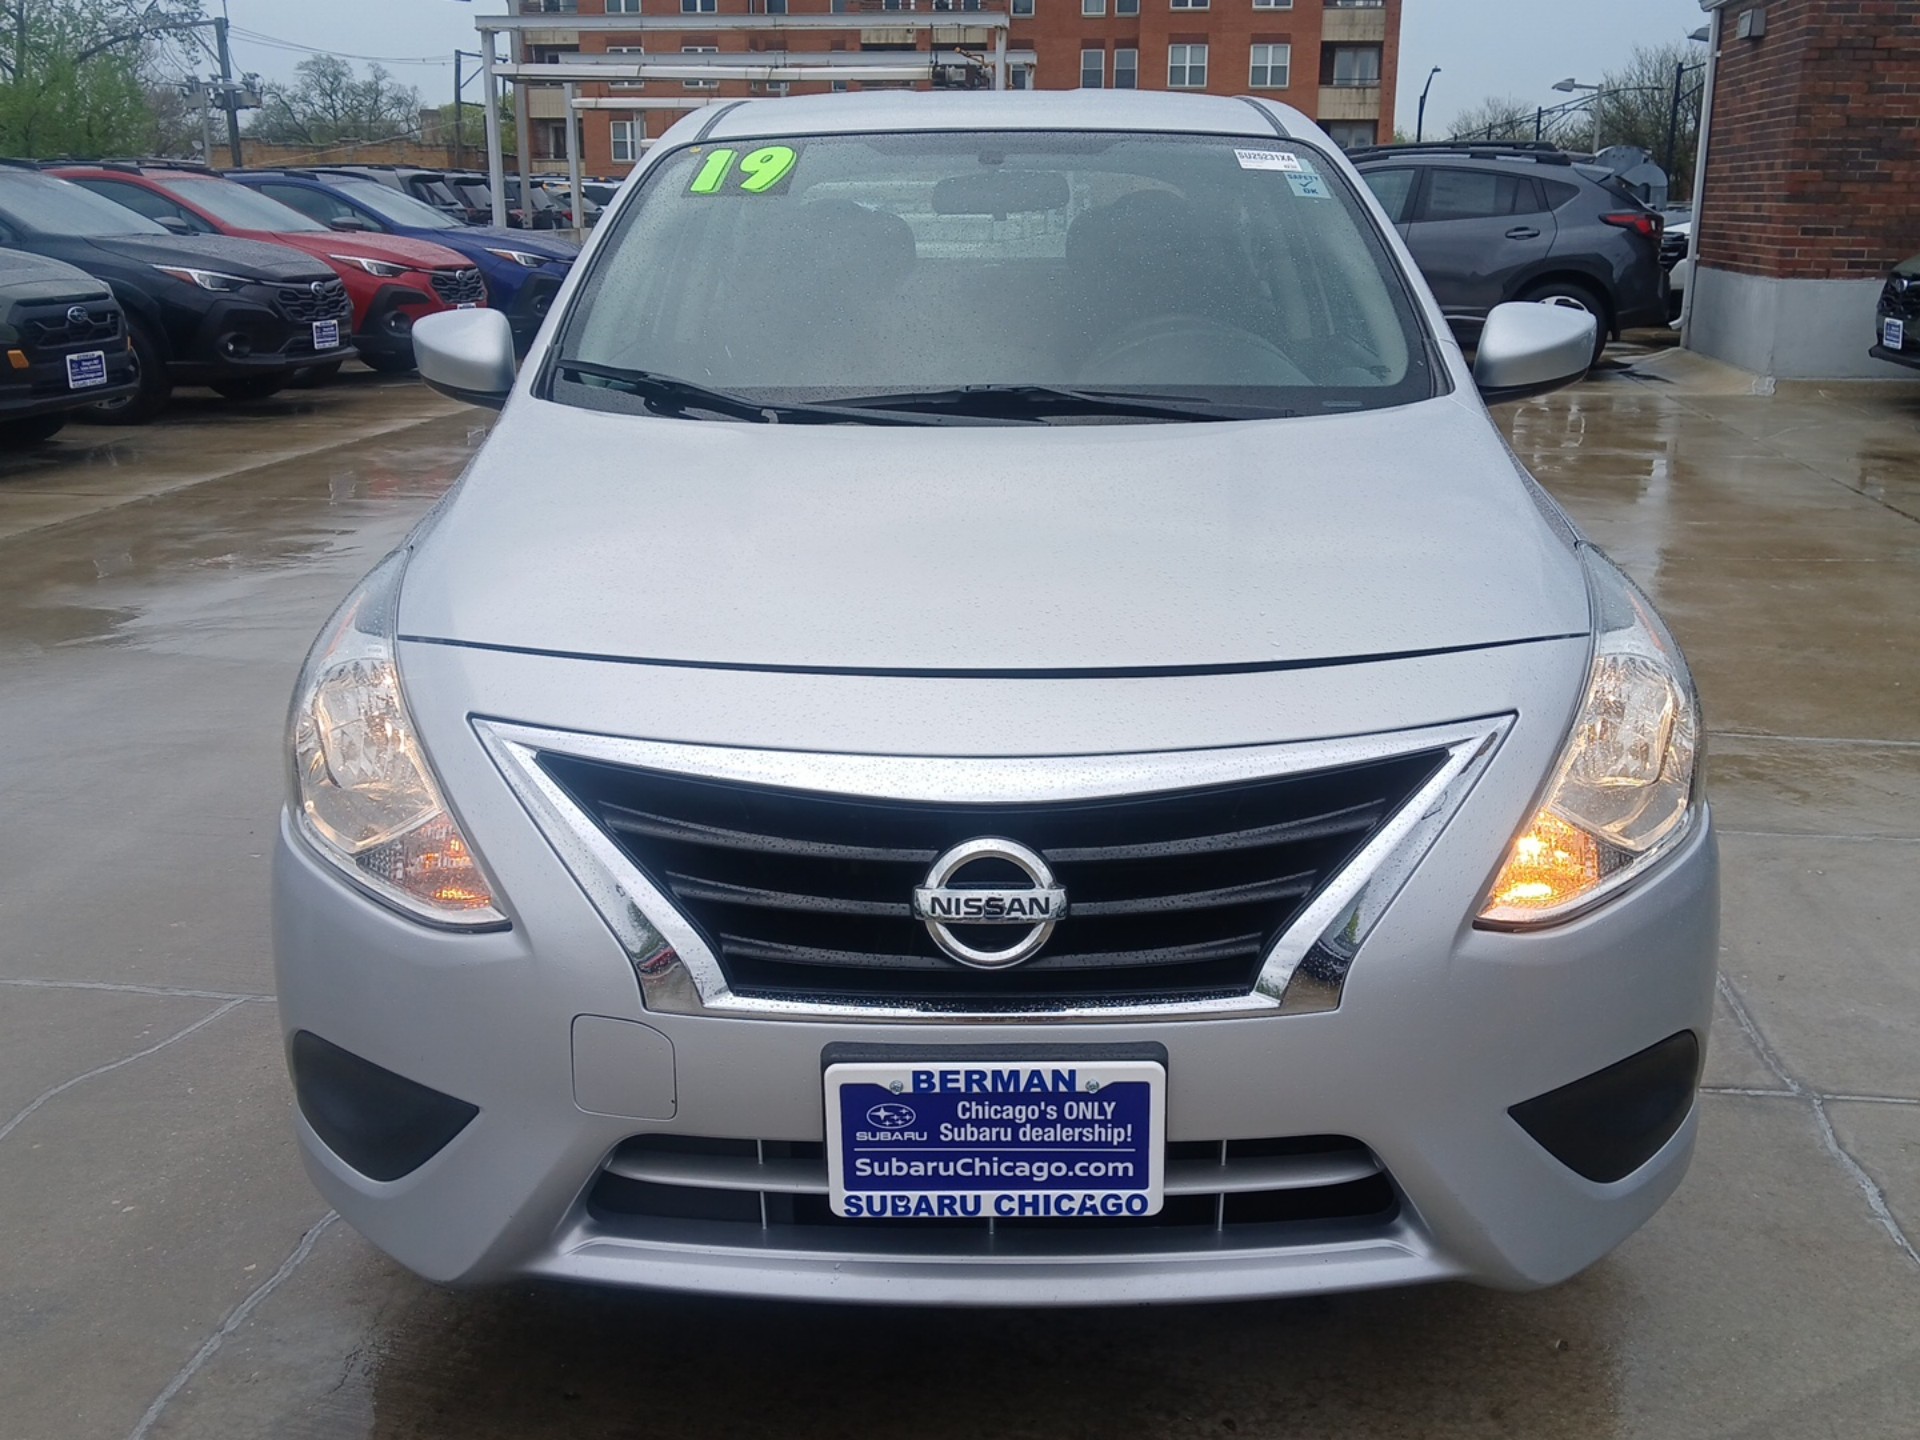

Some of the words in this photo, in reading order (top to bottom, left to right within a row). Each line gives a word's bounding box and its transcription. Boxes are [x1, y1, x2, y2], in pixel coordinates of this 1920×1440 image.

[690, 145, 797, 194] 19
[931, 896, 1050, 917] NISSAN
[911, 1069, 1077, 1093] BERMAN
[957, 1101, 1057, 1122] Chicago's
[1064, 1101, 1117, 1120] ONLY
[855, 1131, 928, 1141] SUBARU
[939, 1123, 1012, 1142] Subaru
[1018, 1123, 1133, 1145] dealership!
[855, 1157, 1134, 1181] SubaruChicago.com
[844, 1194, 982, 1217] SUBARU
[994, 1193, 1149, 1216] CHICAGO
